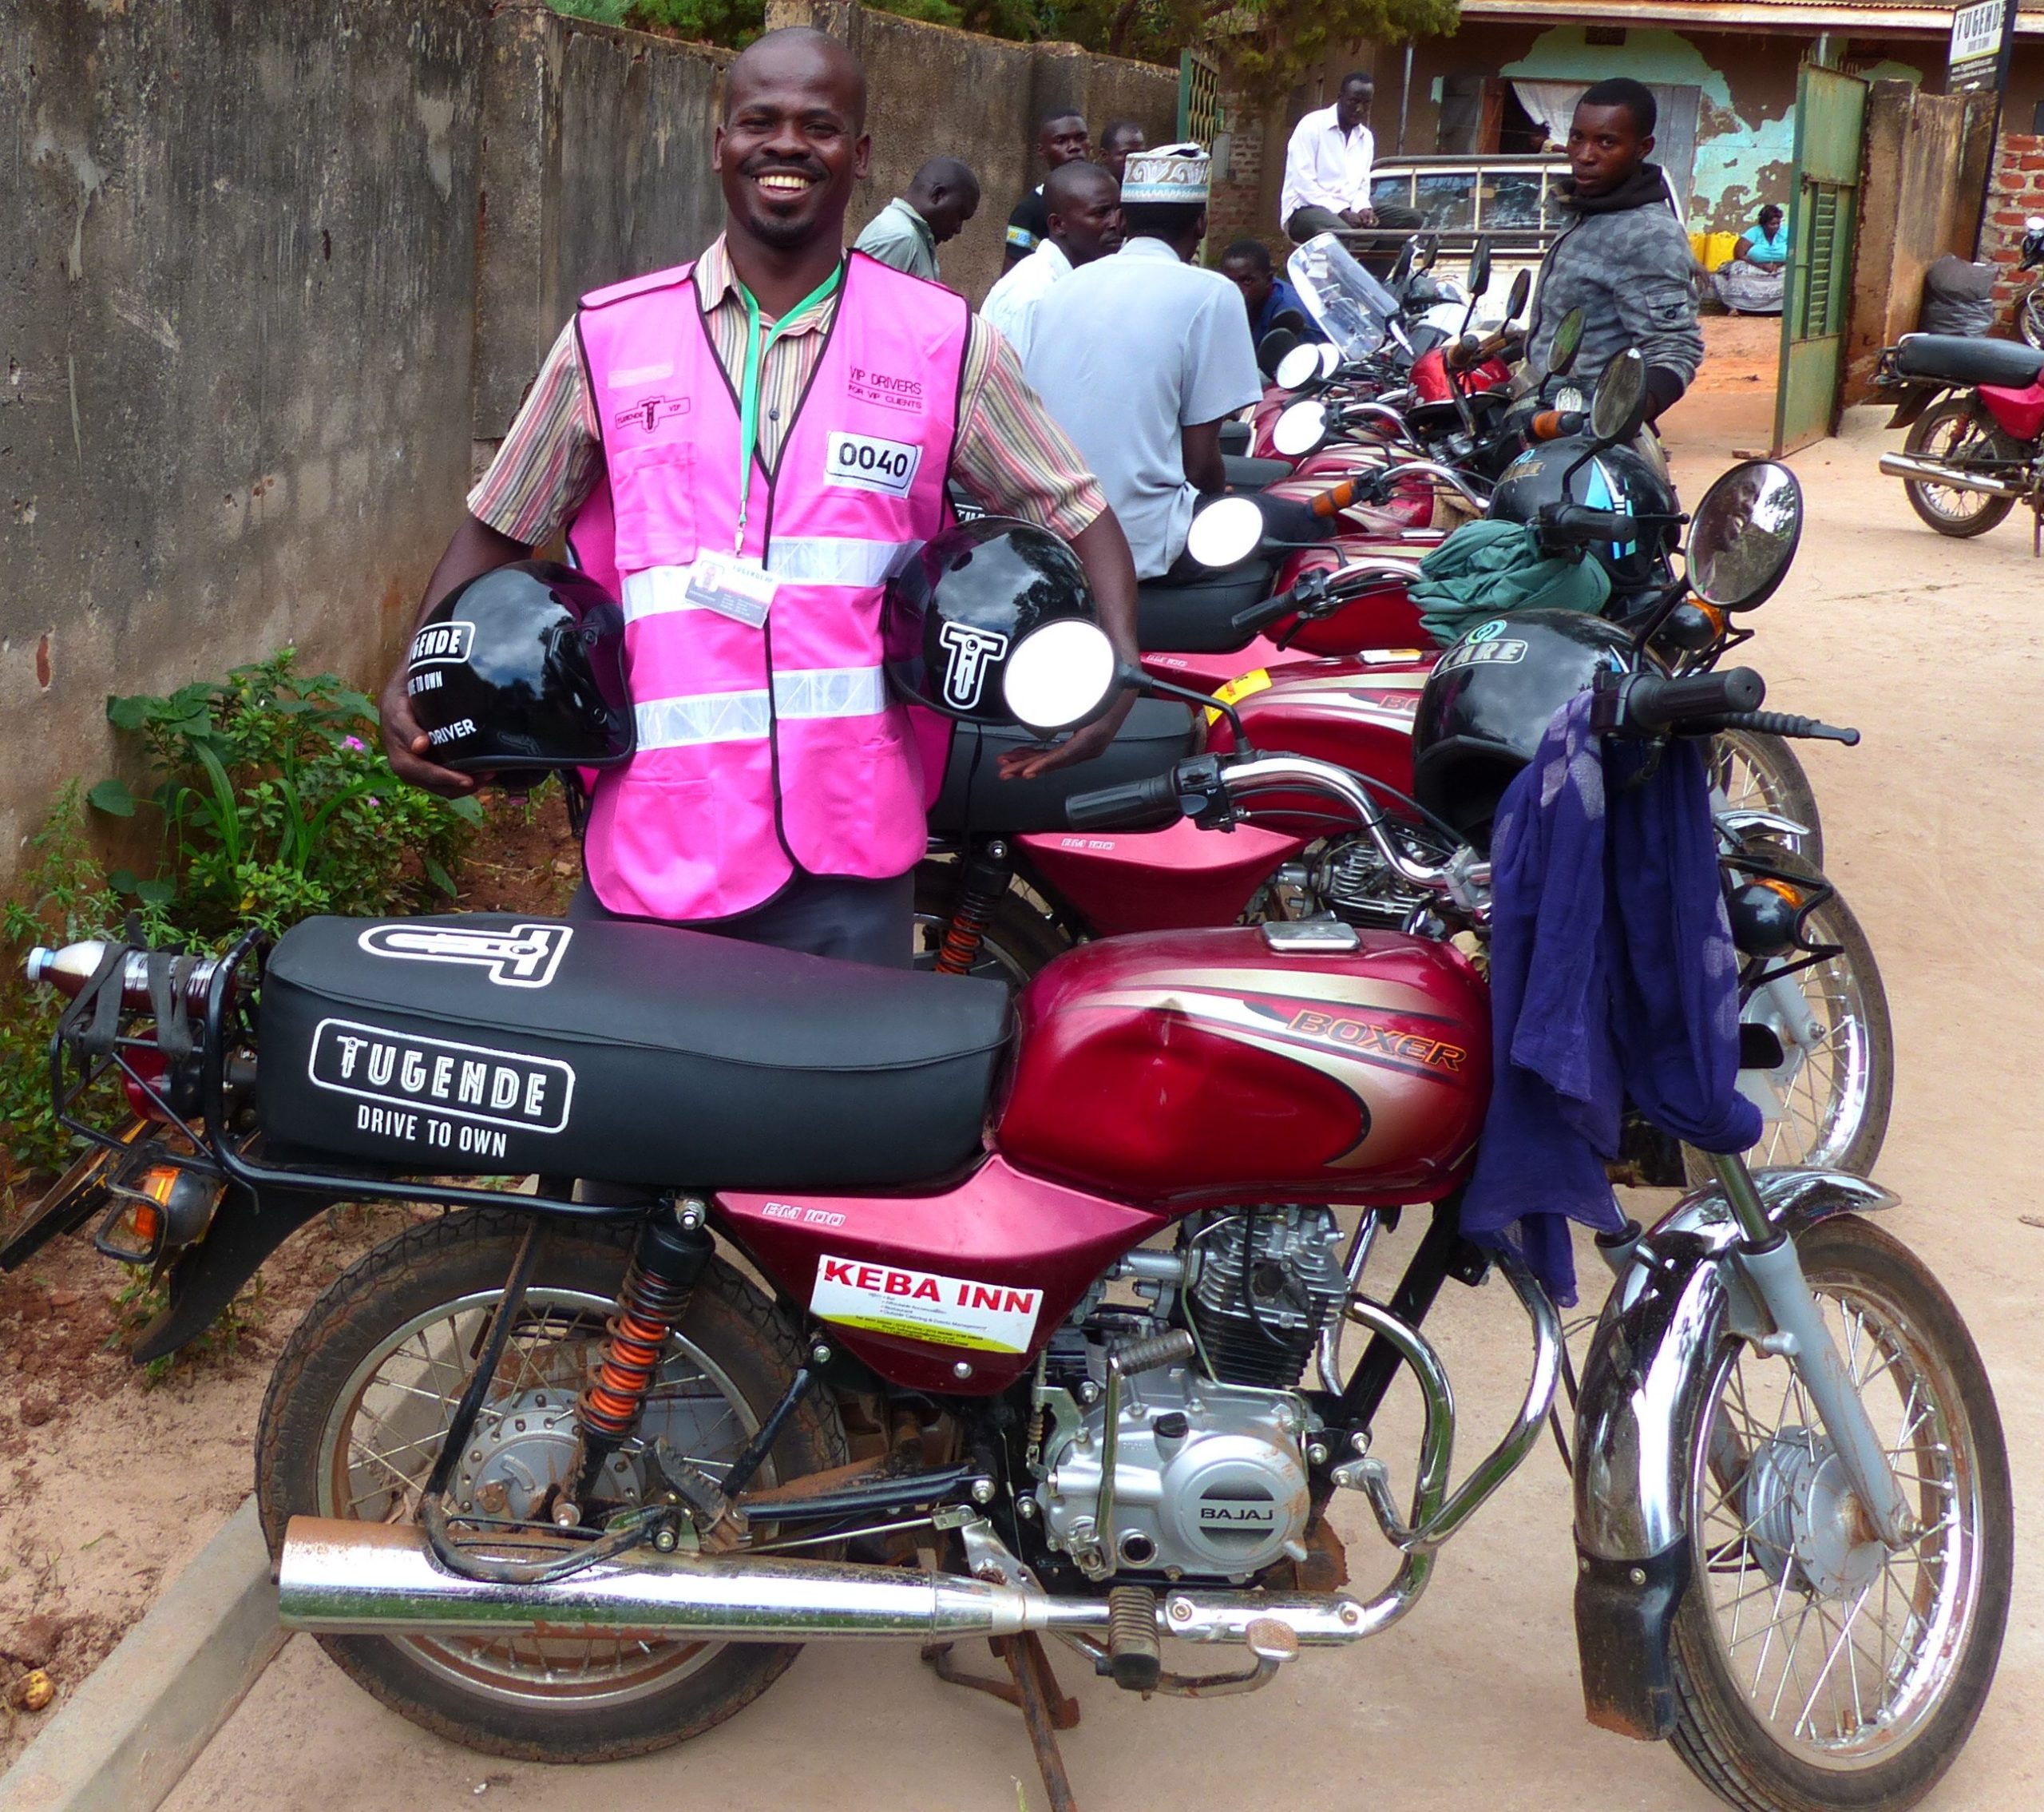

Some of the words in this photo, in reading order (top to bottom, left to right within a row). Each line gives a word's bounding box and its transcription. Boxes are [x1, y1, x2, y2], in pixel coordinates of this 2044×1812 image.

[850, 365, 866, 381] VIP
[871, 373, 922, 395] DRIVERS
[848, 384, 864, 395] FOR
[867, 390, 880, 400] VIP
[885, 395, 922, 410] CLIENTS
[839, 442, 909, 478] 0040
[428, 718, 477, 745] DRIVER
[1286, 1009, 1467, 1072] BOXER
[336, 1035, 548, 1116] TUGENDE
[357, 1104, 418, 1142] DRIVE
[427, 1118, 452, 1148] TO
[458, 1125, 508, 1159] OWN
[804, 1208, 846, 1227] 100
[823, 1259, 941, 1303] KEBA
[957, 1284, 1034, 1314] INN
[1200, 1508, 1274, 1521] BAJAJ
